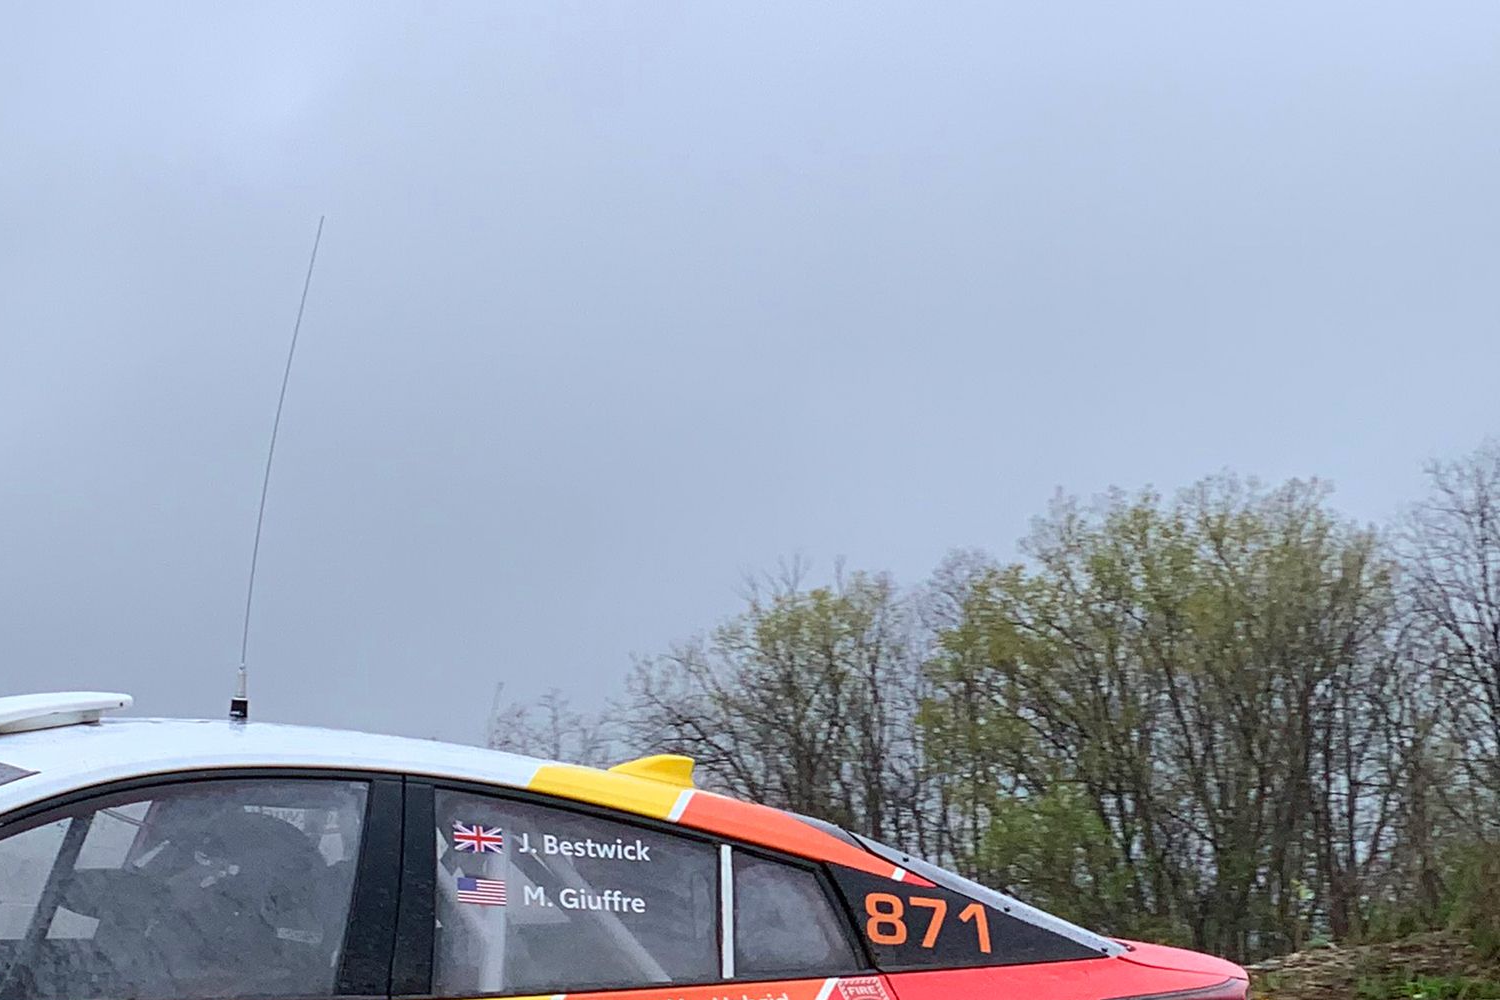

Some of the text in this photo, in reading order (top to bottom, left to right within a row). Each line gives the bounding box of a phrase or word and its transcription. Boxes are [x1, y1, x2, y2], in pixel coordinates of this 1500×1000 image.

[518, 833, 650, 862] J. Bestwick
[523, 885, 646, 914] M. Giuffre
[864, 891, 992, 955] 871
[846, 985, 879, 996] FIRE
